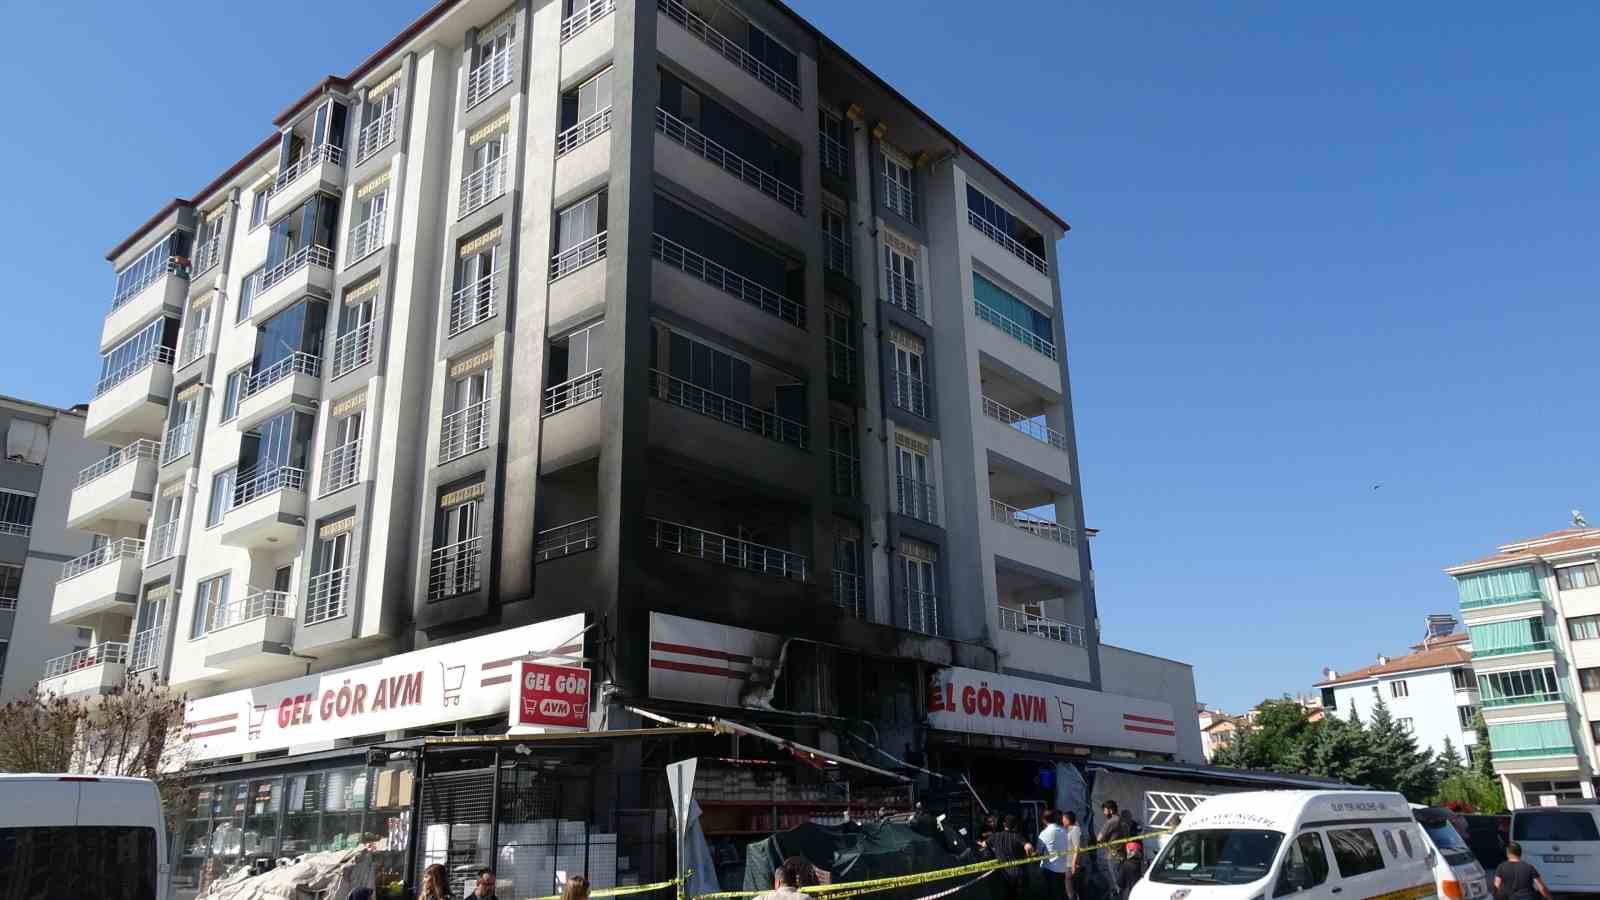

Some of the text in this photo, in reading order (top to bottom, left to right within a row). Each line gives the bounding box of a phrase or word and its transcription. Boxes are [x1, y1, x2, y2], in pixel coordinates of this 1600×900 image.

[278, 671, 424, 728] GEL GÖR AVM
[525, 672, 587, 695] GEL GÖR
[543, 702, 568, 714] AVM
[928, 682, 1047, 723] EL GÖR AVM
